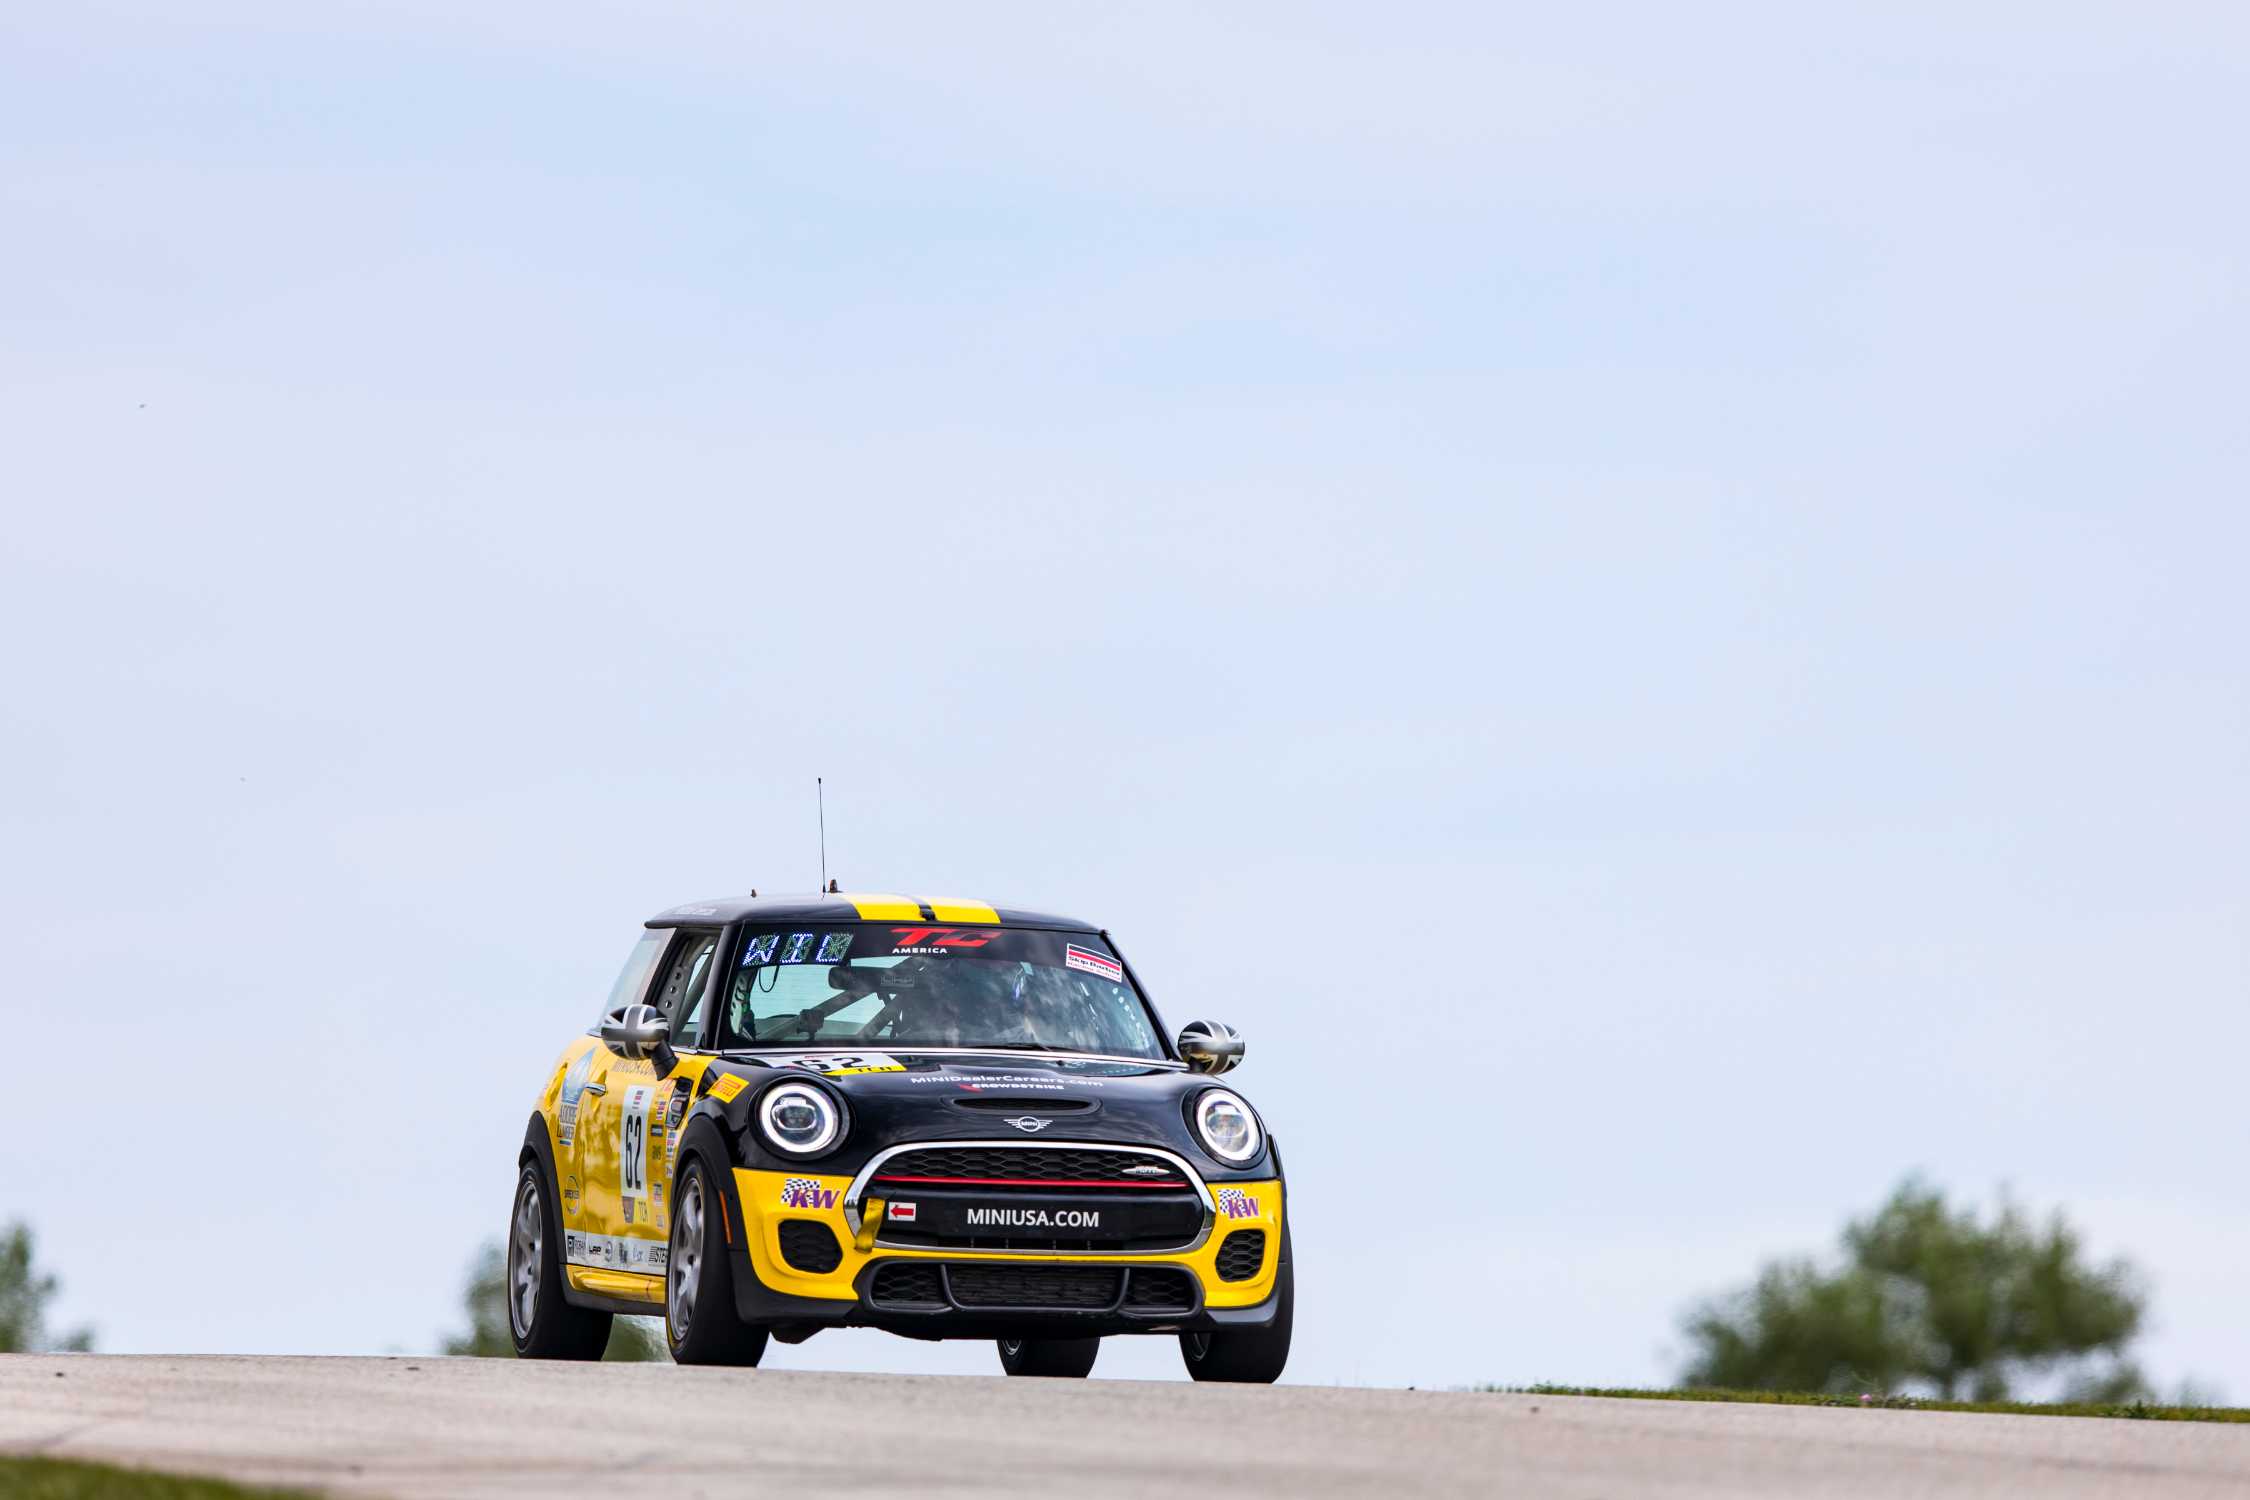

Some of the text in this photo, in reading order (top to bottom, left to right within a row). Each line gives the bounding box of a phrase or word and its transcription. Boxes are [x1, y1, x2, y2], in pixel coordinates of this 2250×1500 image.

[891, 927, 1004, 947] TC
[792, 1057, 869, 1073] 62
[625, 1114, 642, 1190] 62
[789, 1190, 841, 1209] KW
[1227, 1198, 1259, 1219] KW
[967, 1208, 1099, 1227] MINIUSA.COM
